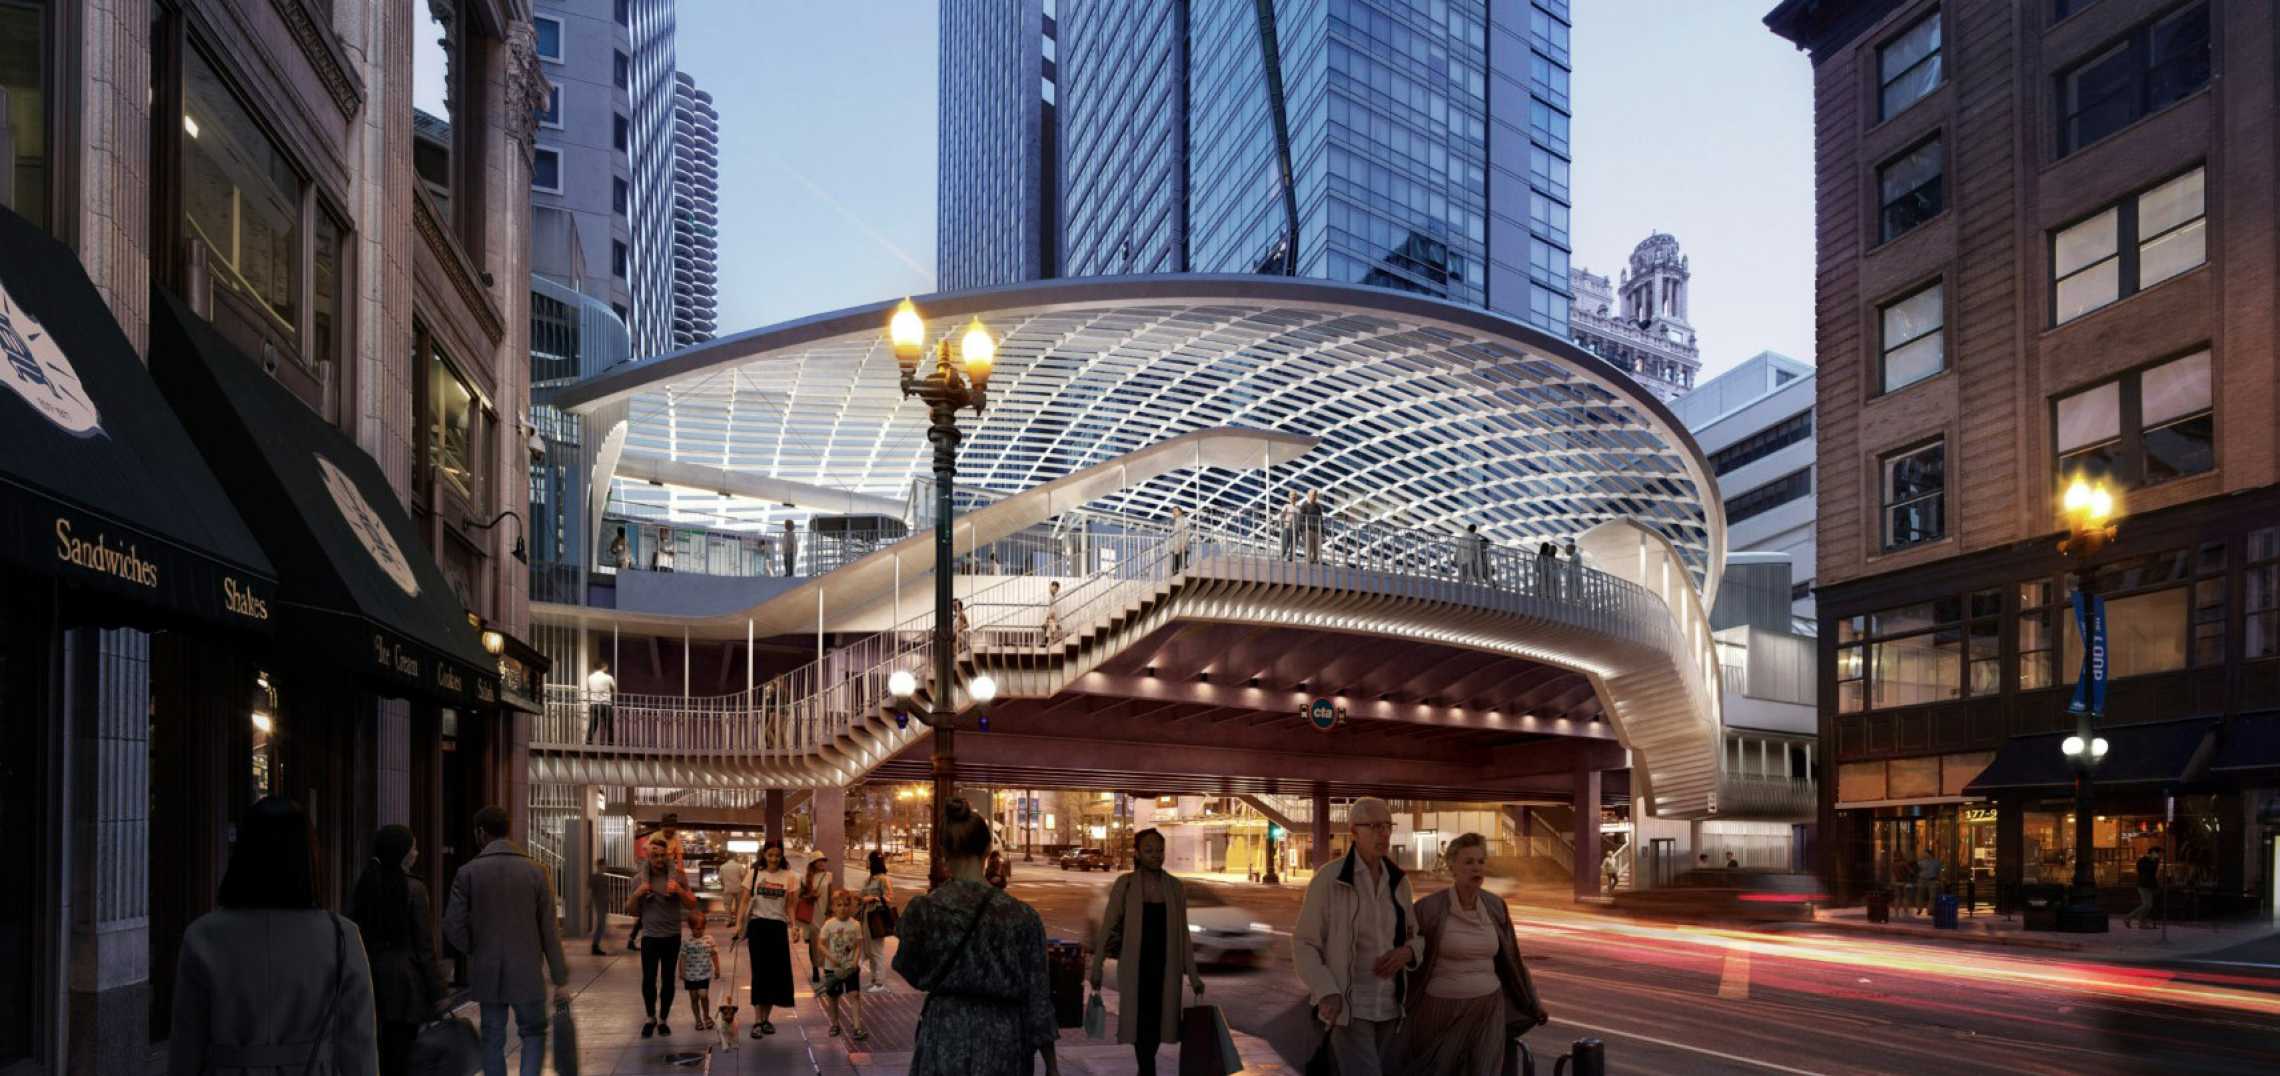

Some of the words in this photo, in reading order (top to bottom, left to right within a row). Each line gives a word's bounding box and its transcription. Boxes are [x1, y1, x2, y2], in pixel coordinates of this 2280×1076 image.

[55, 518, 159, 588] Sandwiches
[223, 577, 269, 620] Shakes
[2092, 635, 2104, 681] LOOP
[1313, 707, 1333, 720] cta
